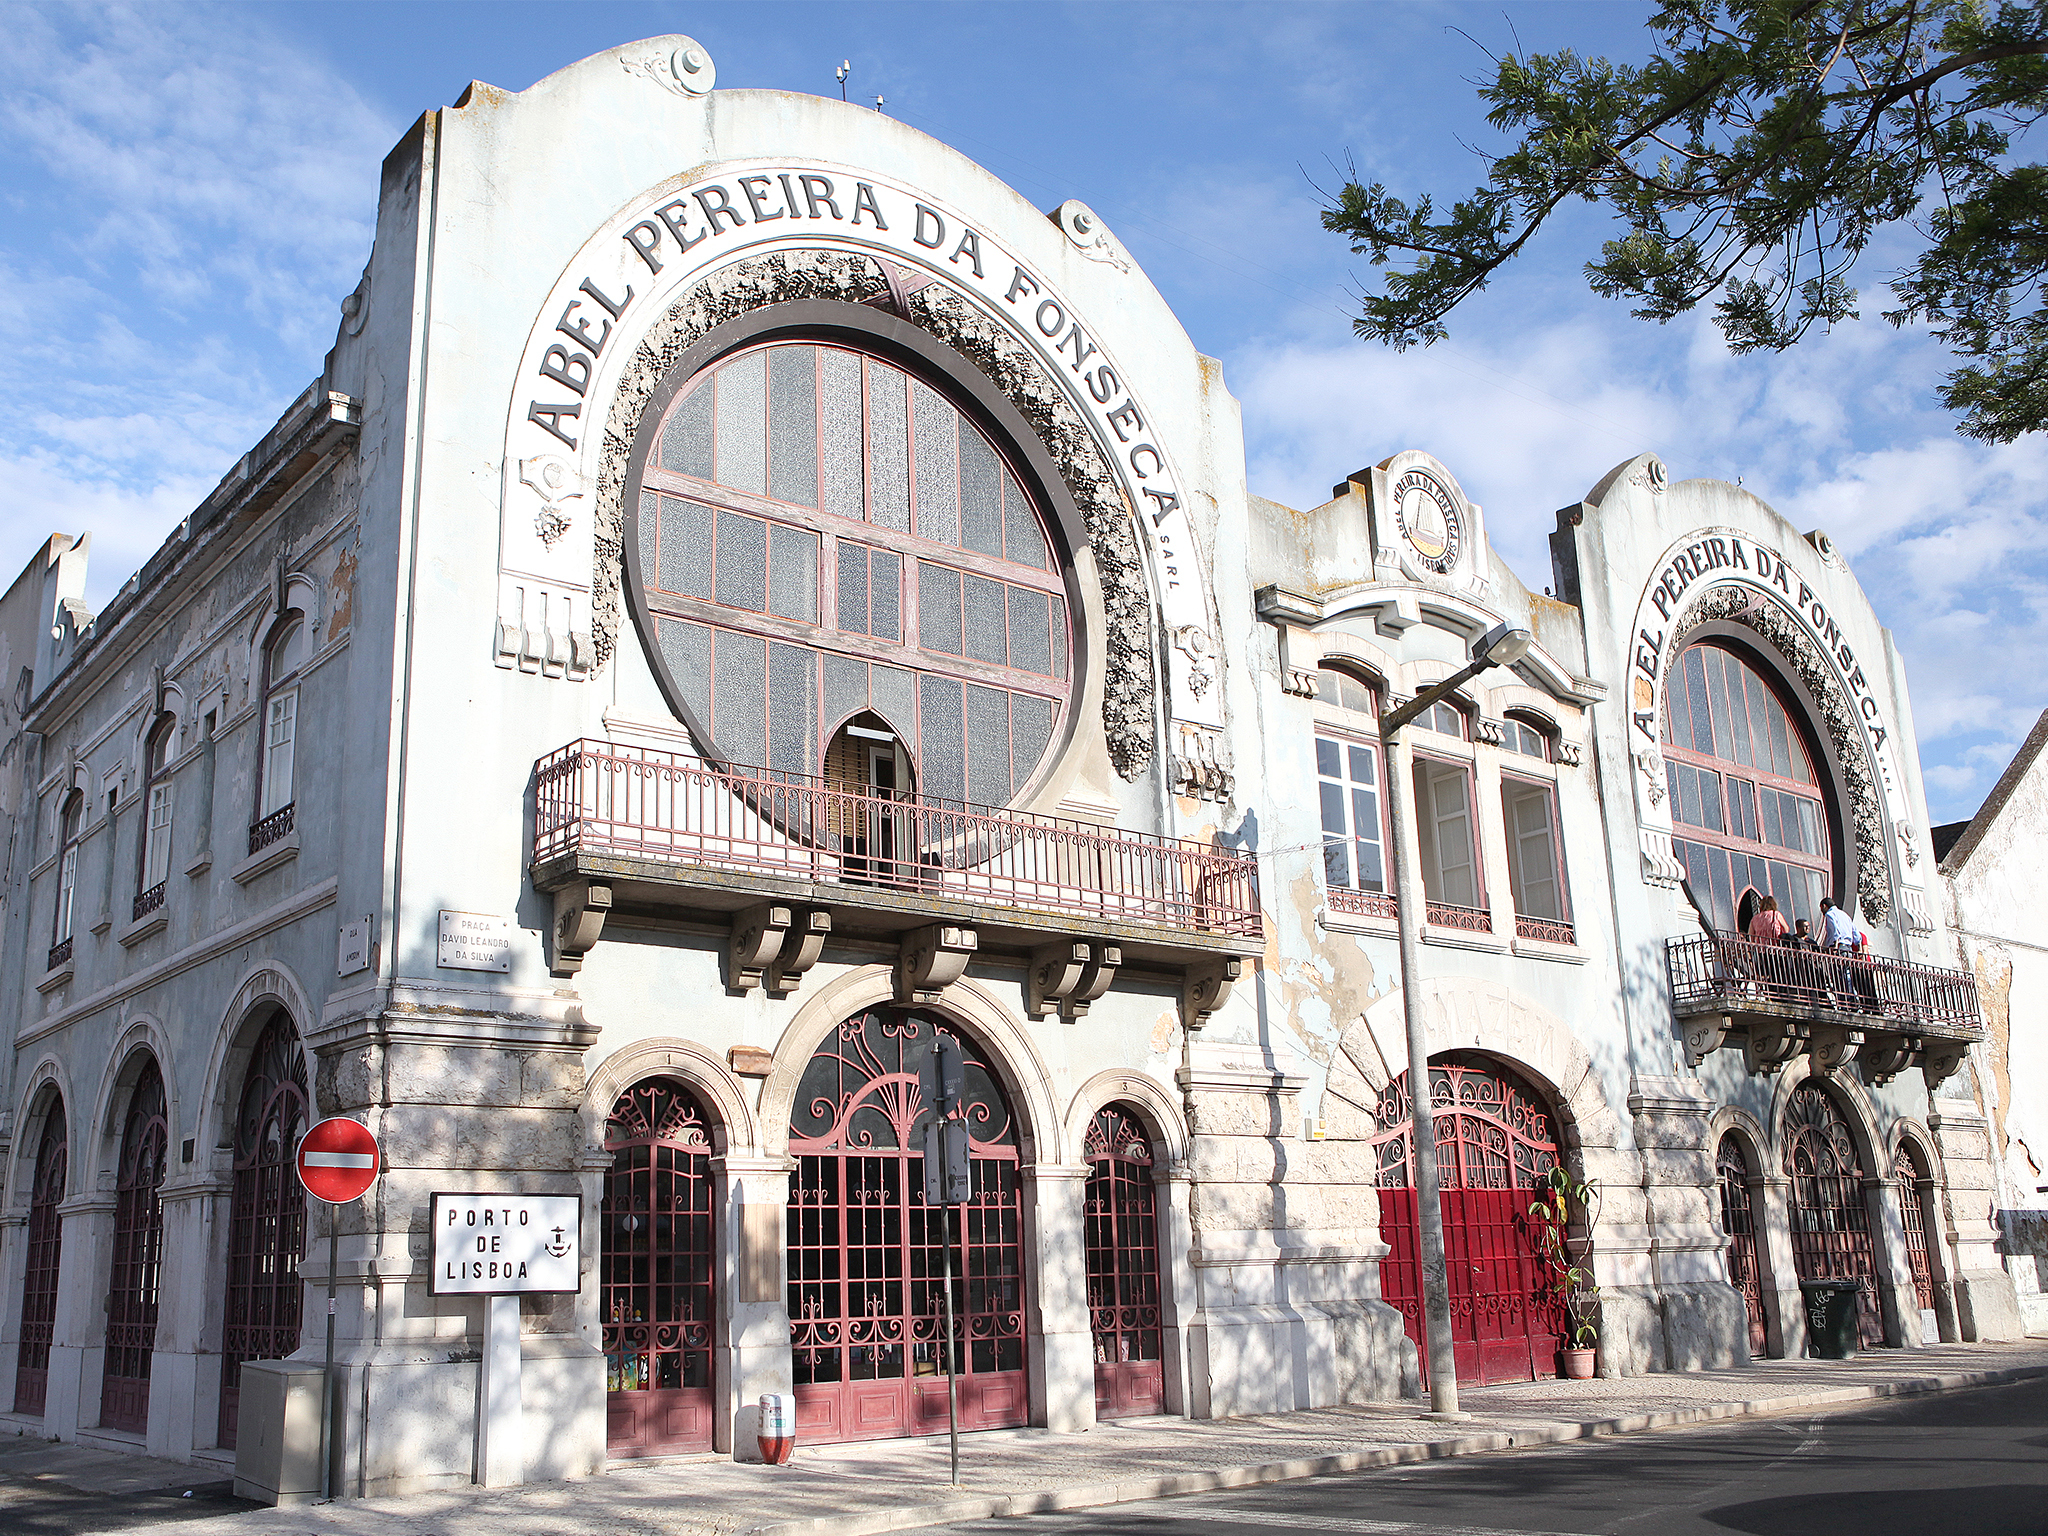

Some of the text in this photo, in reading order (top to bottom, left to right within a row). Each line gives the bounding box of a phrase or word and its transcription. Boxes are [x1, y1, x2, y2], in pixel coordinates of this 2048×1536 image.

[527, 276, 635, 451] ABEL
[622, 172, 890, 275] PEREIRA
[914, 202, 985, 280] DA
[1005, 265, 1181, 530] FONSECA
[1394, 474, 1421, 504] PEREIRA
[1423, 477, 1433, 493] DA
[1434, 488, 1458, 540] FONSECA
[1652, 538, 1749, 622] PEREIRA
[1755, 547, 1790, 594] DA
[1798, 582, 1887, 752] FONSECA
[442, 933, 509, 949] DAVID LEANDRO
[455, 950, 495, 963] DA SILVA
[1474, 1034, 1480, 1047] 4
[1122, 1082, 1128, 1091] 3
[448, 1209, 529, 1228] PORTO
[476, 1235, 501, 1253] DE
[446, 1261, 528, 1280] LISBOA
